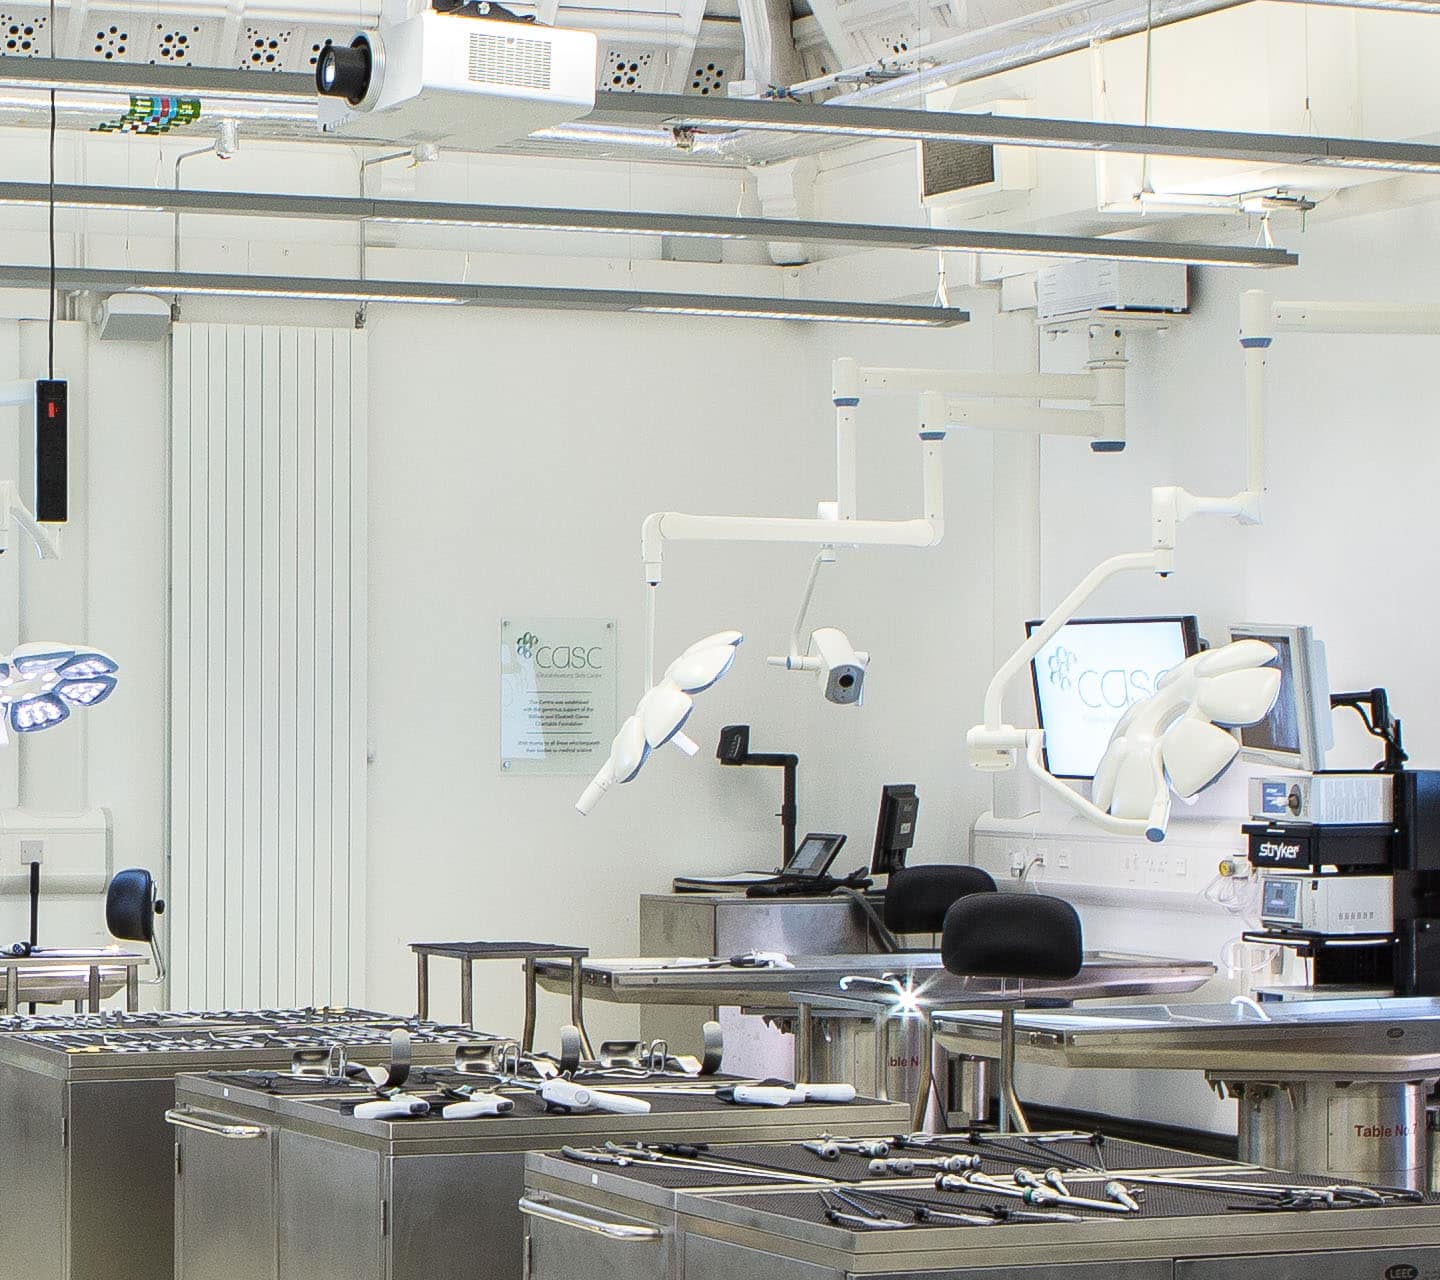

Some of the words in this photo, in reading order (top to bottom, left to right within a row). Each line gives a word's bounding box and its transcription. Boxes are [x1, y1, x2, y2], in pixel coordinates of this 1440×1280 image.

[535, 645, 603, 669] casc
[1258, 841, 1300, 861] stryker
[1354, 1124, 1392, 1138] Table
